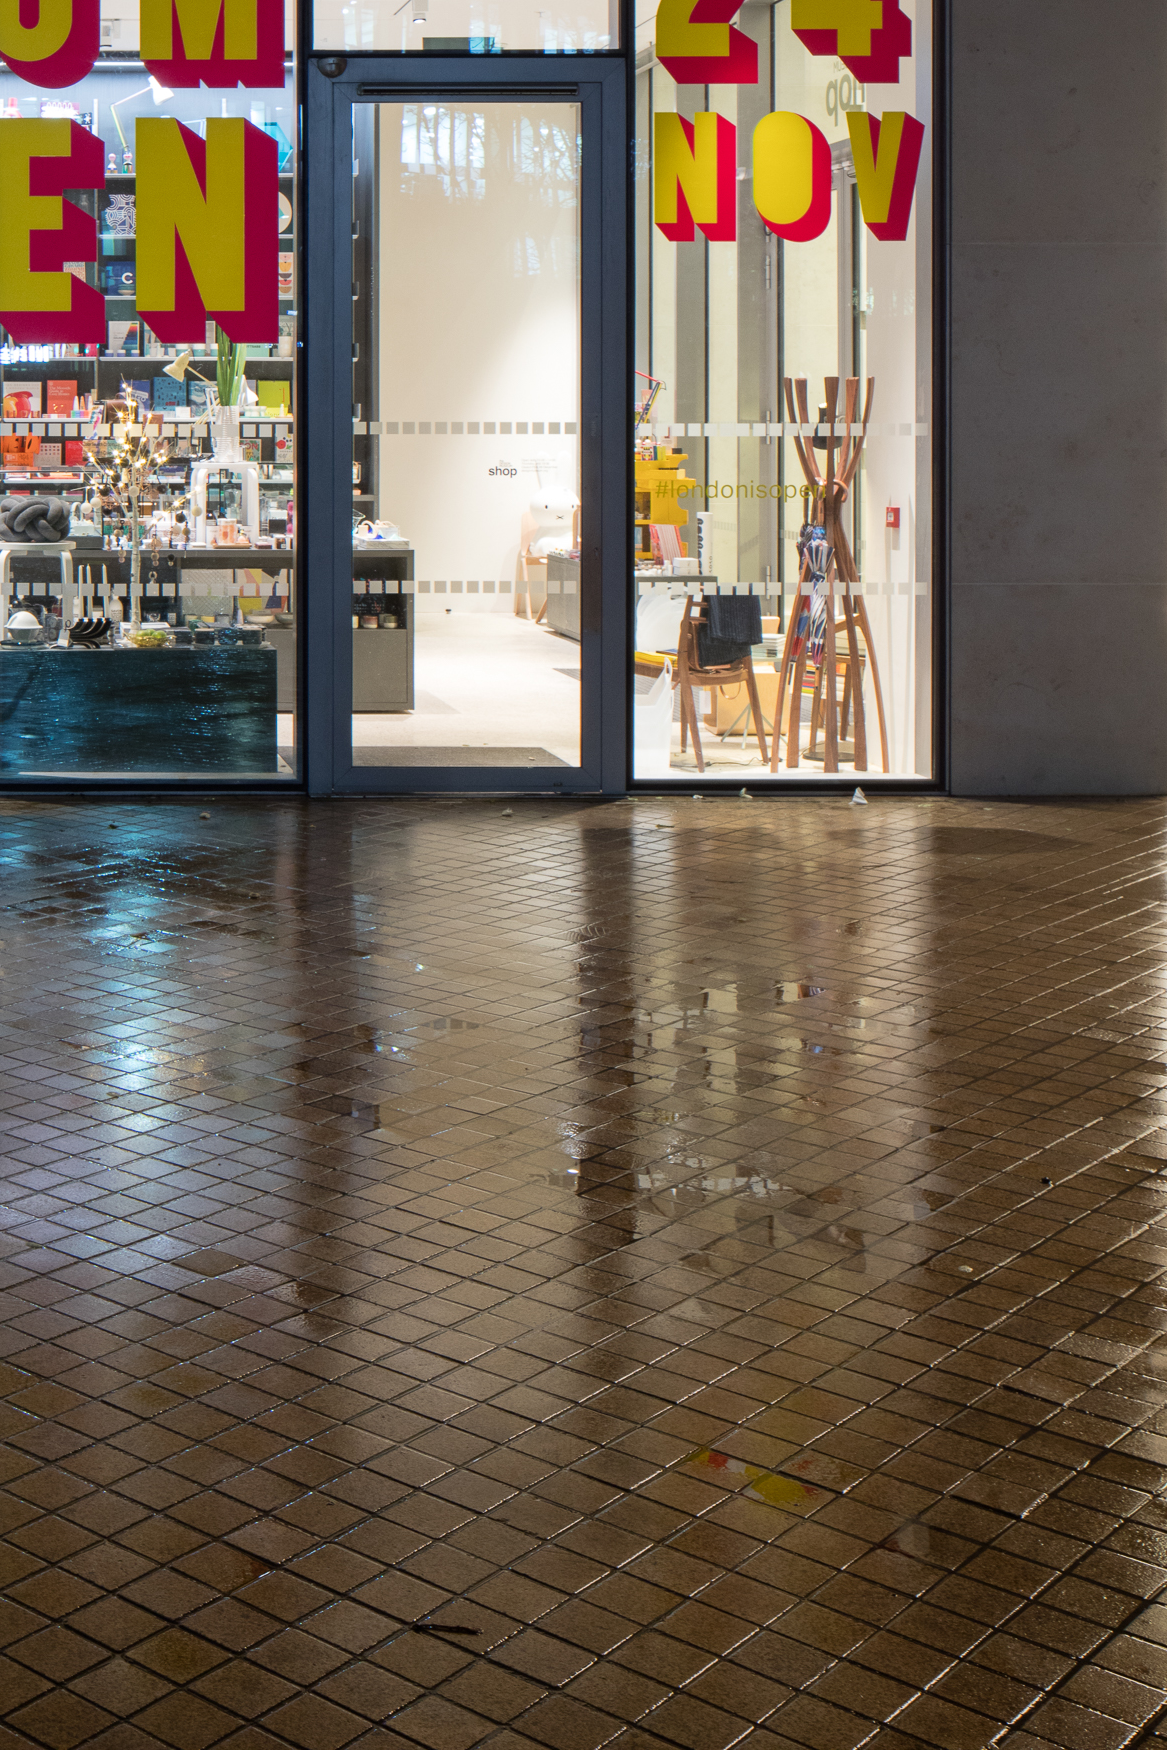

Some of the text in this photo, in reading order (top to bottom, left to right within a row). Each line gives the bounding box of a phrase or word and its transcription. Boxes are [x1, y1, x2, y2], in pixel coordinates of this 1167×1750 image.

[654, 110, 925, 243] NOV
[488, 466, 518, 478] shop
[655, 480, 827, 503] #londonisopen
